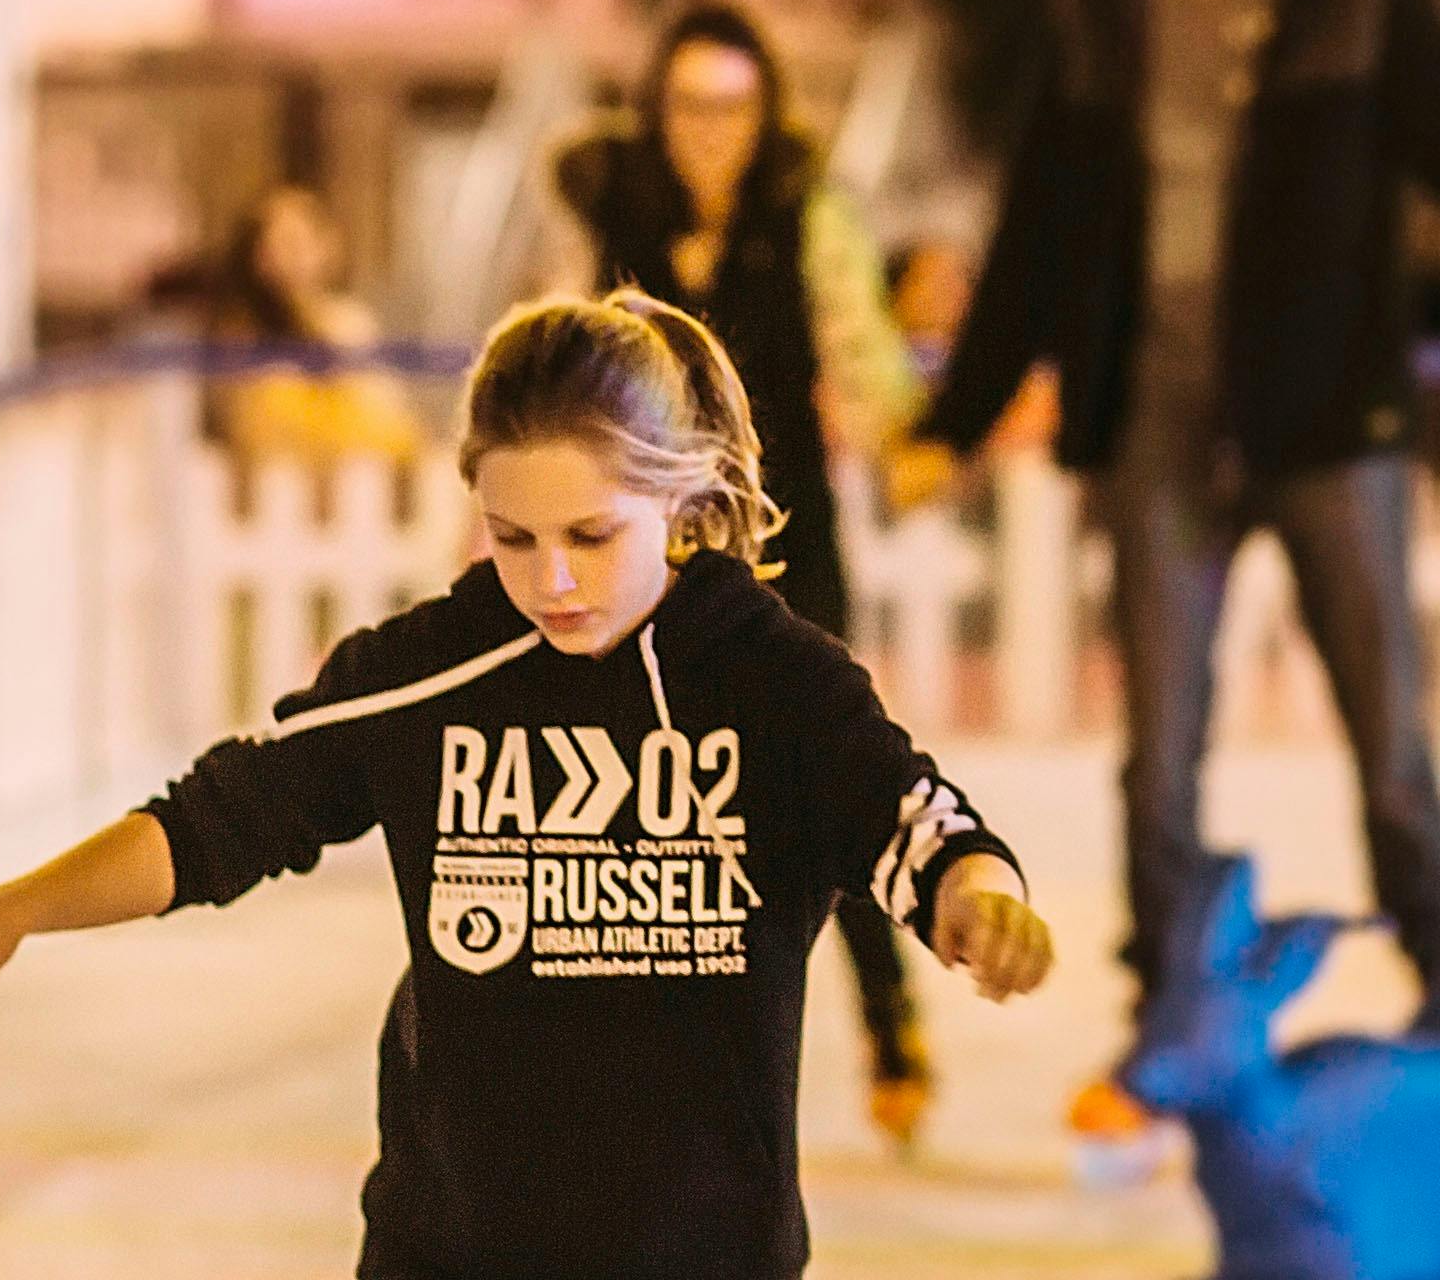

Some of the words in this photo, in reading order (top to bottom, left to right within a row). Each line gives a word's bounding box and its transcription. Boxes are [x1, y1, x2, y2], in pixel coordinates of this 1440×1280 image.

[533, 857, 747, 923] RUSSELL
[532, 926, 599, 953] URBAN
[602, 926, 691, 953] ATHLETIC
[694, 926, 746, 953] DEPT.
